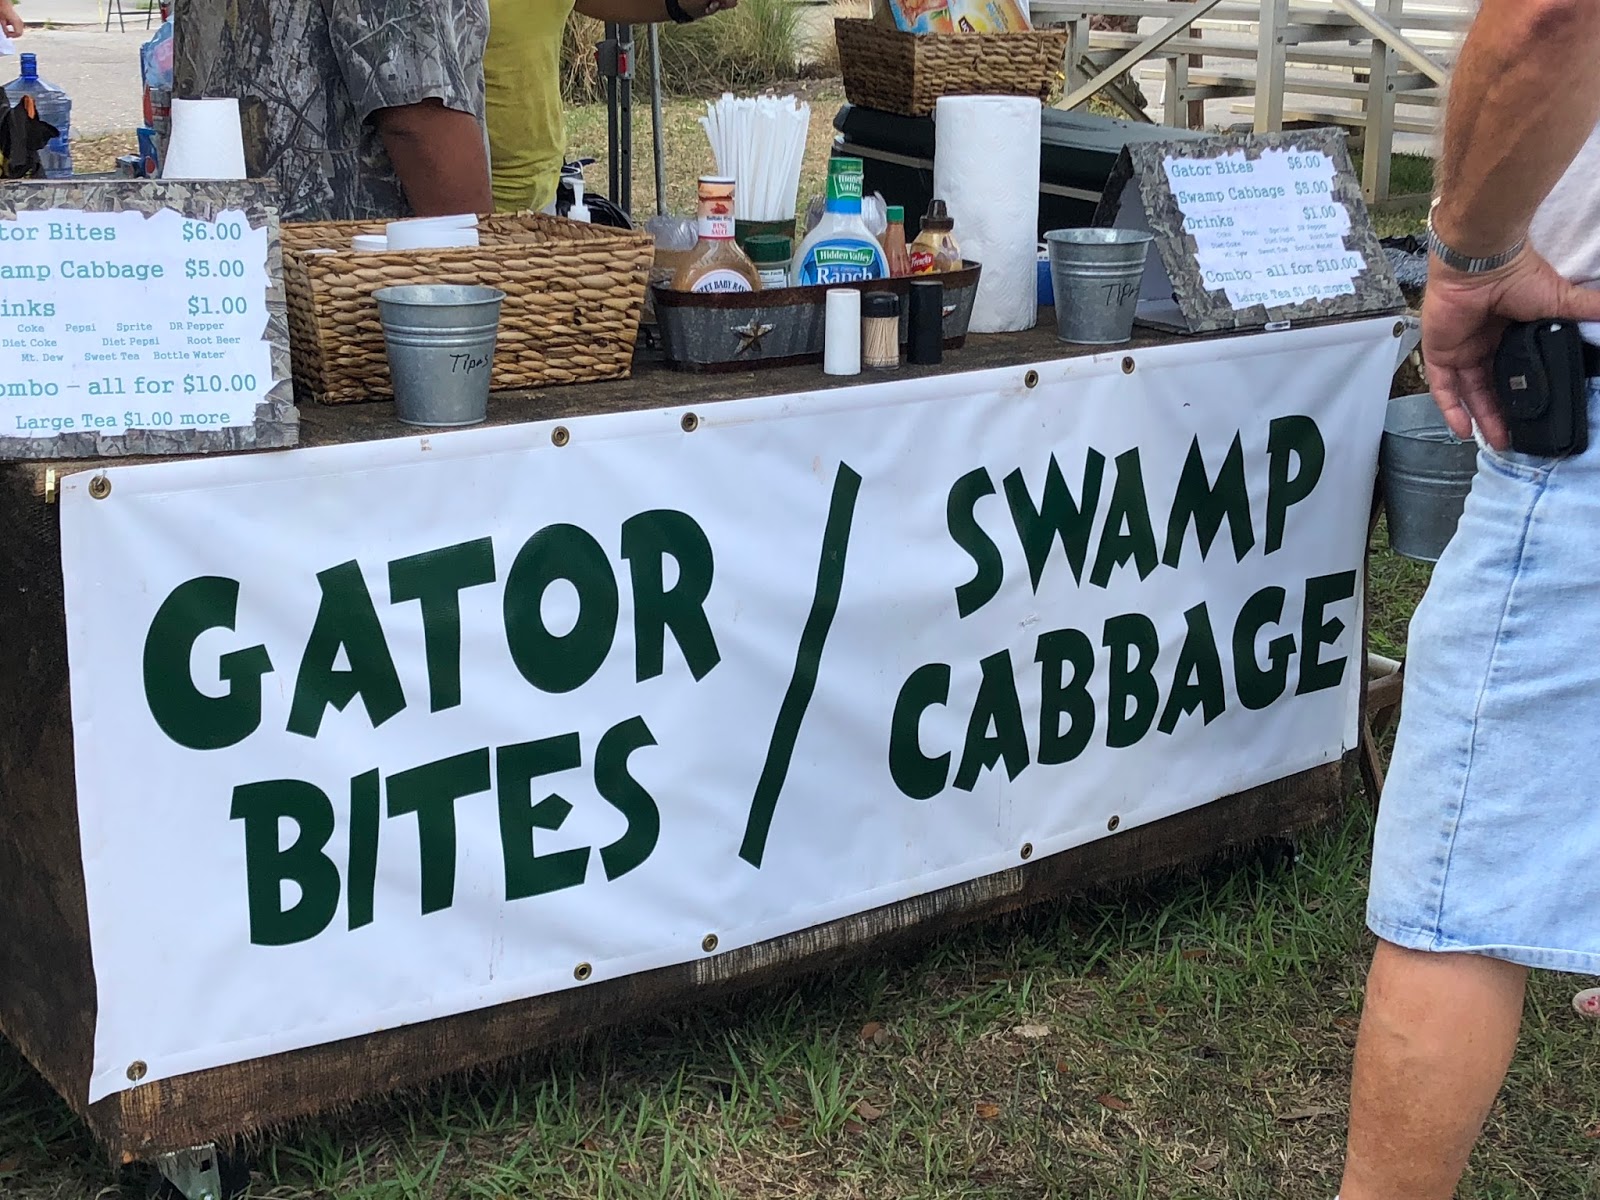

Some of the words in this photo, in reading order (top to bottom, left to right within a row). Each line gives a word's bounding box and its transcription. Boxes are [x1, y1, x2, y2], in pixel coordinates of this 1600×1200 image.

[1171, 163, 1212, 178] Gator
[1217, 160, 1254, 175] Bites
[1178, 190, 1225, 205] Swamp
[1228, 185, 1285, 202] Cabbage
[1186, 215, 1235, 231] Drinks
[1302, 206, 1337, 221] $1.00
[48, 222, 116, 241] Bites
[182, 220, 241, 242] $6.00
[820, 250, 848, 260] Hidden
[849, 252, 871, 264] Valley
[1, 265, 51, 281] amp
[60, 260, 164, 280] Cabbage
[185, 258, 244, 279] $5.00
[816, 267, 873, 285] Ranch
[1205, 268, 1253, 285] Combo
[1267, 265, 1289, 279] all
[1291, 261, 1313, 275] for
[1316, 256, 1358, 273] $10.00
[1, 299, 56, 317] inks
[188, 295, 247, 316] $1.00
[18, 324, 45, 333] Coke
[65, 323, 96, 333] Pepsi
[117, 322, 152, 333] Sprite
[169, 322, 184, 330] DR
[186, 322, 225, 332] Pepper
[2, 338, 27, 347] Diet
[30, 338, 57, 347] Coke
[102, 337, 127, 346] Diet
[129, 337, 160, 347] Pepsi
[187, 336, 213, 345] Root
[216, 335, 241, 344] Beer
[21, 353, 39, 362] Mt.
[43, 353, 64, 362] Dew
[84, 352, 117, 361] Sweet
[120, 352, 140, 361] Tea
[153, 351, 190, 360] Bottle
[192, 351, 226, 360] Water
[88, 377, 125, 395] all
[134, 376, 174, 395] for
[183, 374, 256, 394] $10.00
[15, 415, 75, 431] Large
[82, 413, 118, 428] Tea
[124, 411, 173, 428] $1.00
[180, 412, 230, 425] more
[947, 415, 1325, 619] SWAMP
[143, 509, 721, 750] GATOR
[889, 569, 1357, 800] CABBAGE
[230, 715, 660, 946] BITES
